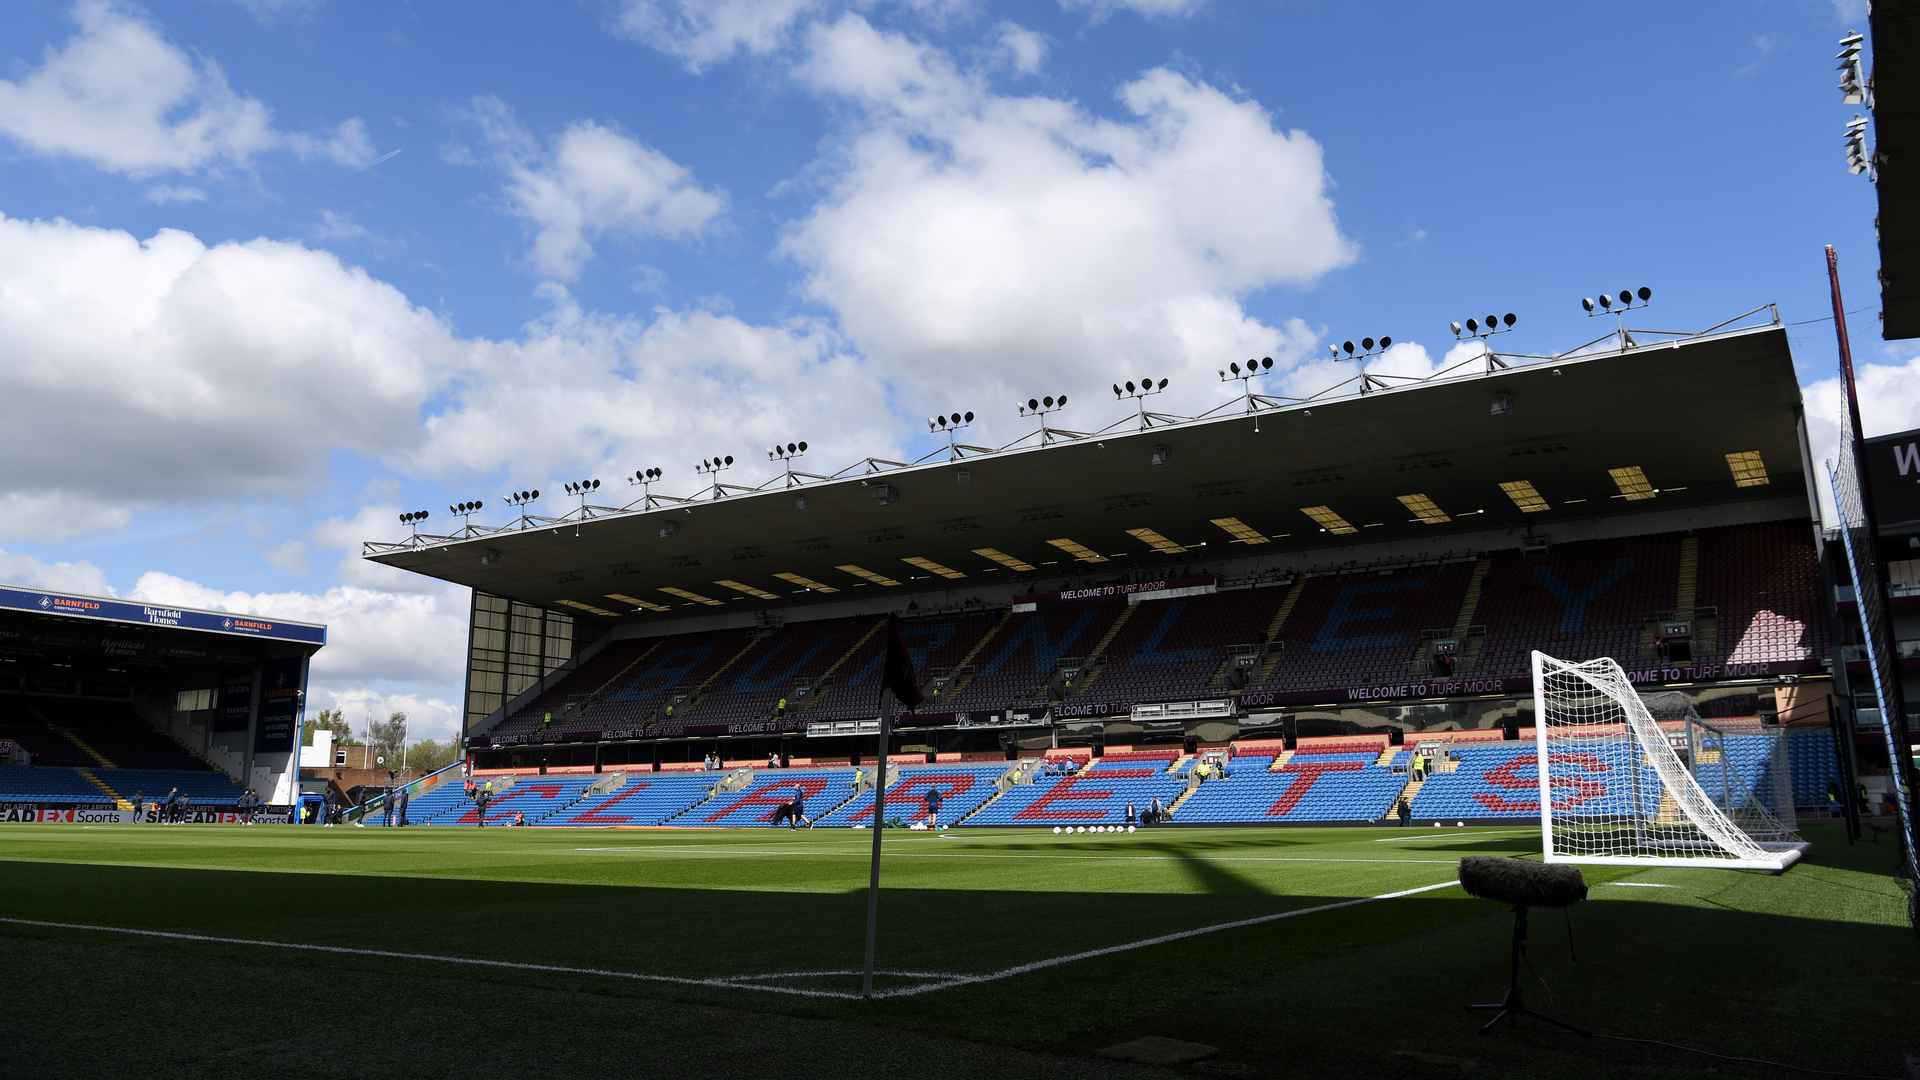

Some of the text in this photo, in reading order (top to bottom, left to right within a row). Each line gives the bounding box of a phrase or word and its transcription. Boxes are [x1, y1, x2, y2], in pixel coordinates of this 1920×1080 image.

[1060, 580, 1166, 600] WELCOME TO TURF MOOR
[54, 598, 100, 609] BARNFIELD
[144, 605, 181, 618] Barnfield
[149, 615, 177, 625] Homes
[234, 620, 272, 631] BARNFIELD
[1662, 669, 1681, 681] TO
[1684, 667, 1722, 680] TURF
[1724, 664, 1769, 678] MOOR
[1348, 679, 1504, 700] WELCOME TO TURF MOOR
[1241, 693, 1275, 705] MOOR
[1055, 704, 1093, 716] ELCOME
[1094, 703, 1108, 714] TO
[601, 728, 635, 739] WELCOME
[636, 727, 644, 737] TO
[728, 722, 765, 734] WELCOME
[766, 722, 776, 732] TO
[490, 735, 518, 745] WELCOME
[519, 735, 528, 743] TO
[458, 752, 1611, 826] CLARETS
[78, 809, 120, 824] Sports
